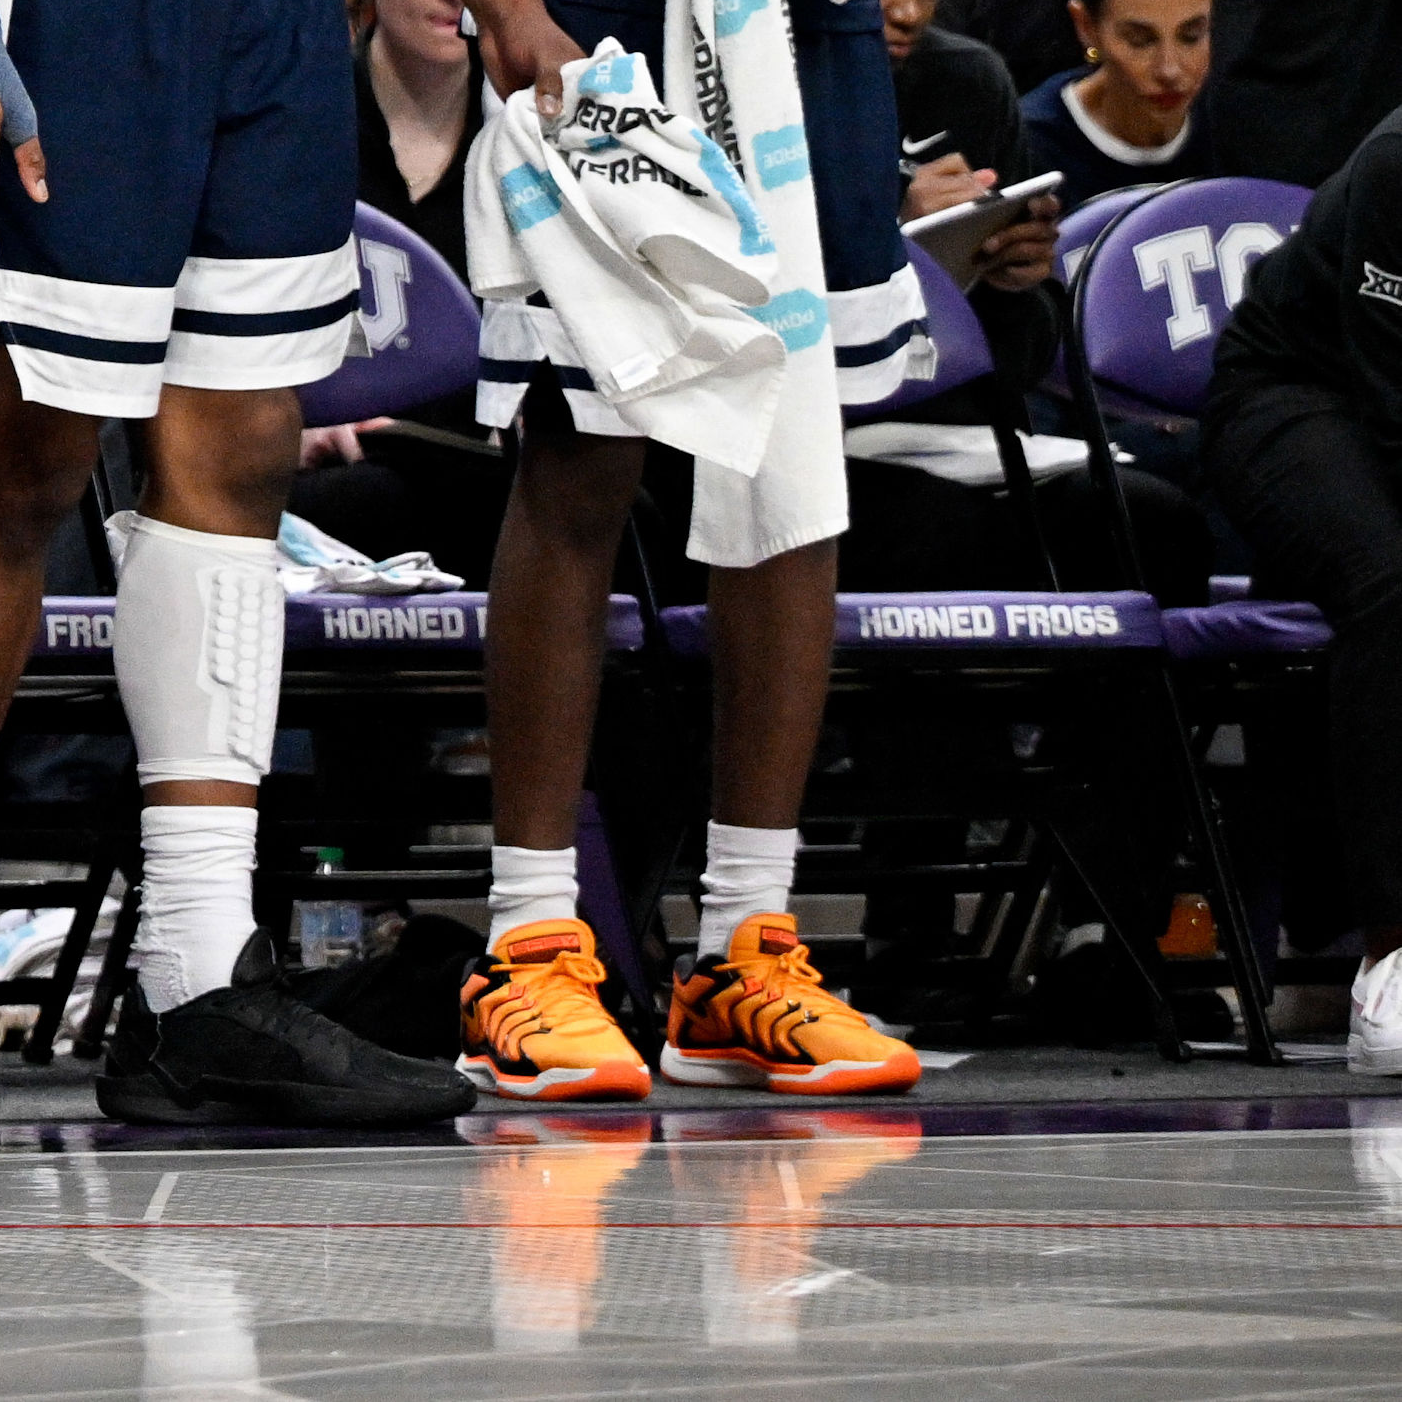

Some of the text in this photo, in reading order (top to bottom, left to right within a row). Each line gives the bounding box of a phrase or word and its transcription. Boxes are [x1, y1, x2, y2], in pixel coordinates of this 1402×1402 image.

[323, 607, 465, 639] HORNED
[858, 604, 1119, 638] HORNED FROGS
